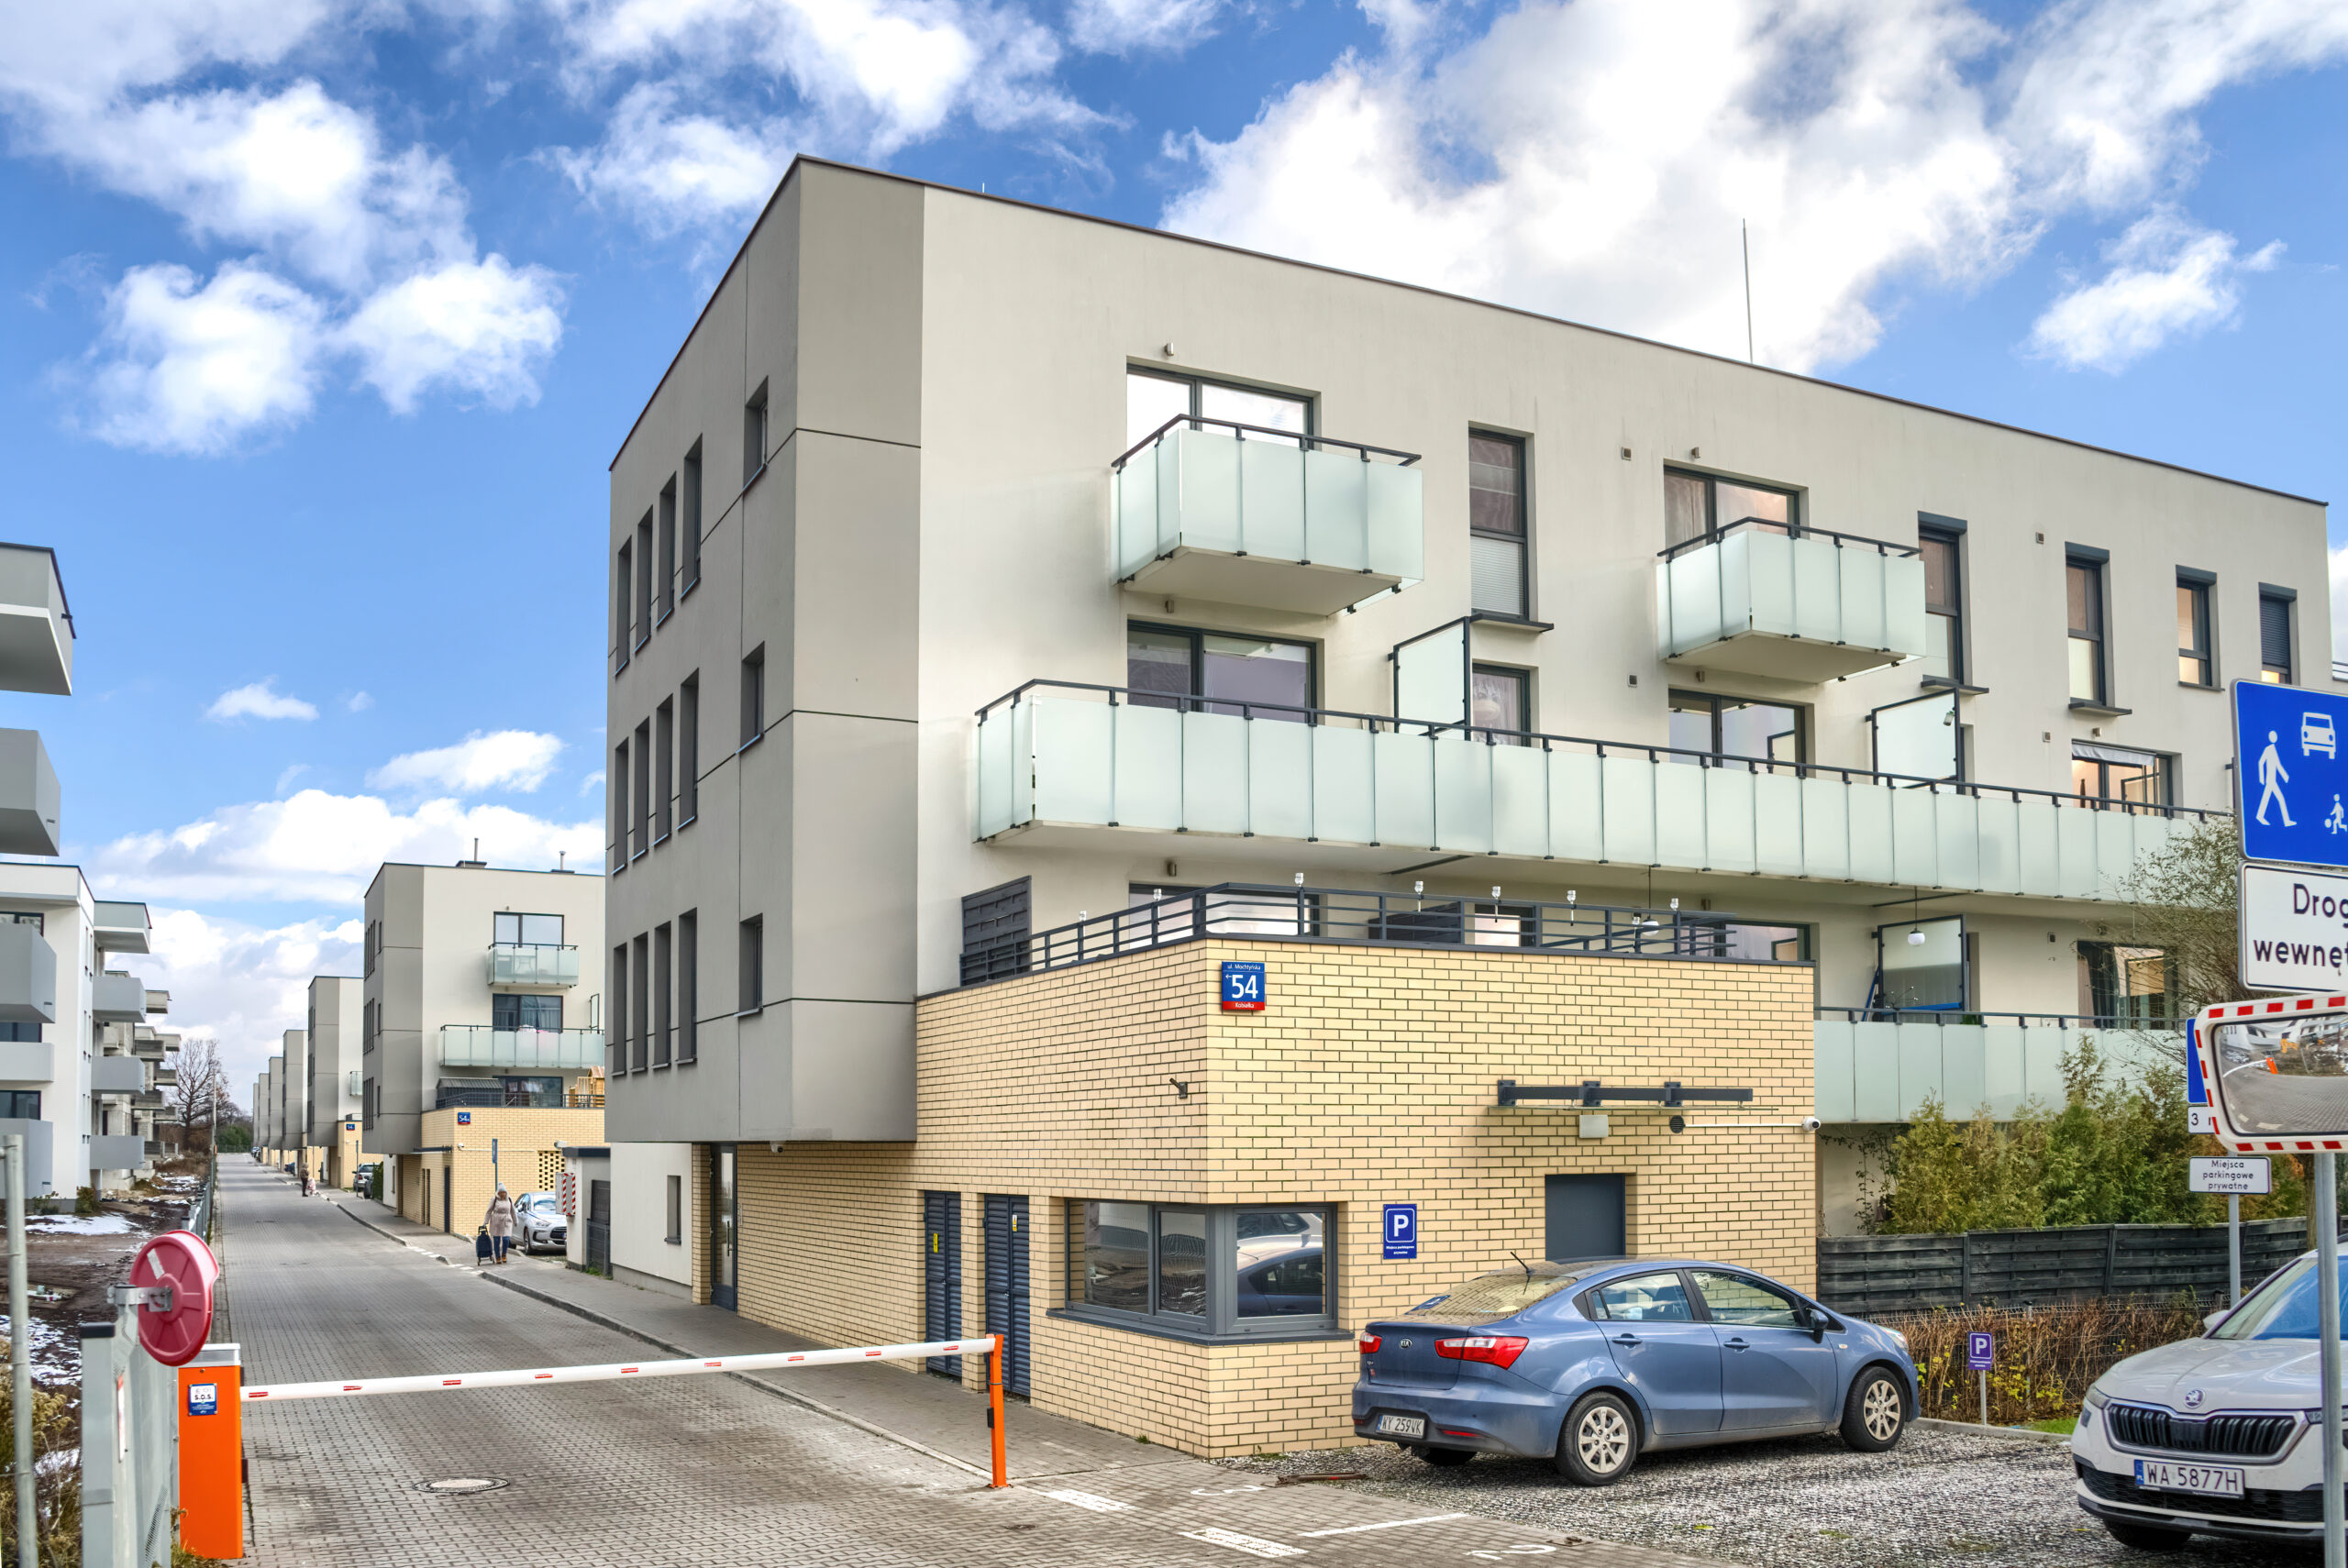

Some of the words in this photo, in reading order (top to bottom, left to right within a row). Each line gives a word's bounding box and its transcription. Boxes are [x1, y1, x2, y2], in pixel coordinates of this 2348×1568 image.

[1231, 974, 1258, 999] 54
[2190, 1112, 2198, 1126] 3
[2211, 1160, 2244, 1170] Miejsca
[2202, 1171, 2254, 1181] parkingowe
[2208, 1182, 2249, 1191] prywatne
[1393, 1214, 1410, 1237] P
[1975, 1337, 1988, 1354] P
[1394, 1418, 1423, 1434] 259VK
[2146, 1463, 2170, 1485] WA
[2177, 1467, 2238, 1492] 5877H
